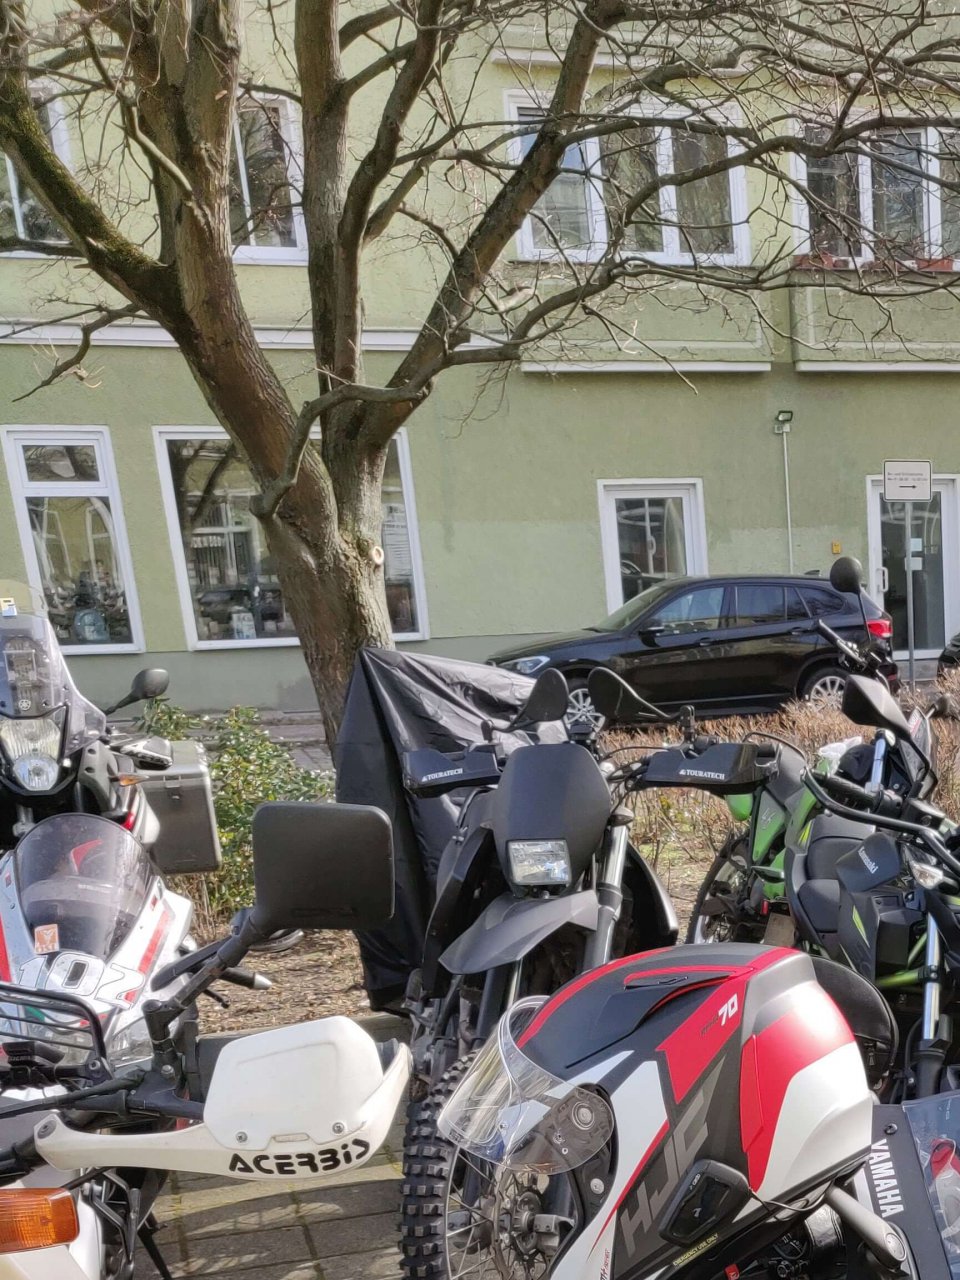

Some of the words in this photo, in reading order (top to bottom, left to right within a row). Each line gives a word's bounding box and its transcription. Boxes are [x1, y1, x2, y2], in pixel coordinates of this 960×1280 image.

[427, 768, 464, 781] TOURATECH
[686, 769, 725, 780] TOURATECH
[19, 951, 145, 1010] 102
[718, 993, 738, 1026] 70
[229, 1138, 370, 1175] ACERBIS
[620, 1088, 708, 1258] HJC
[868, 1138, 904, 1218] YAMAHA
